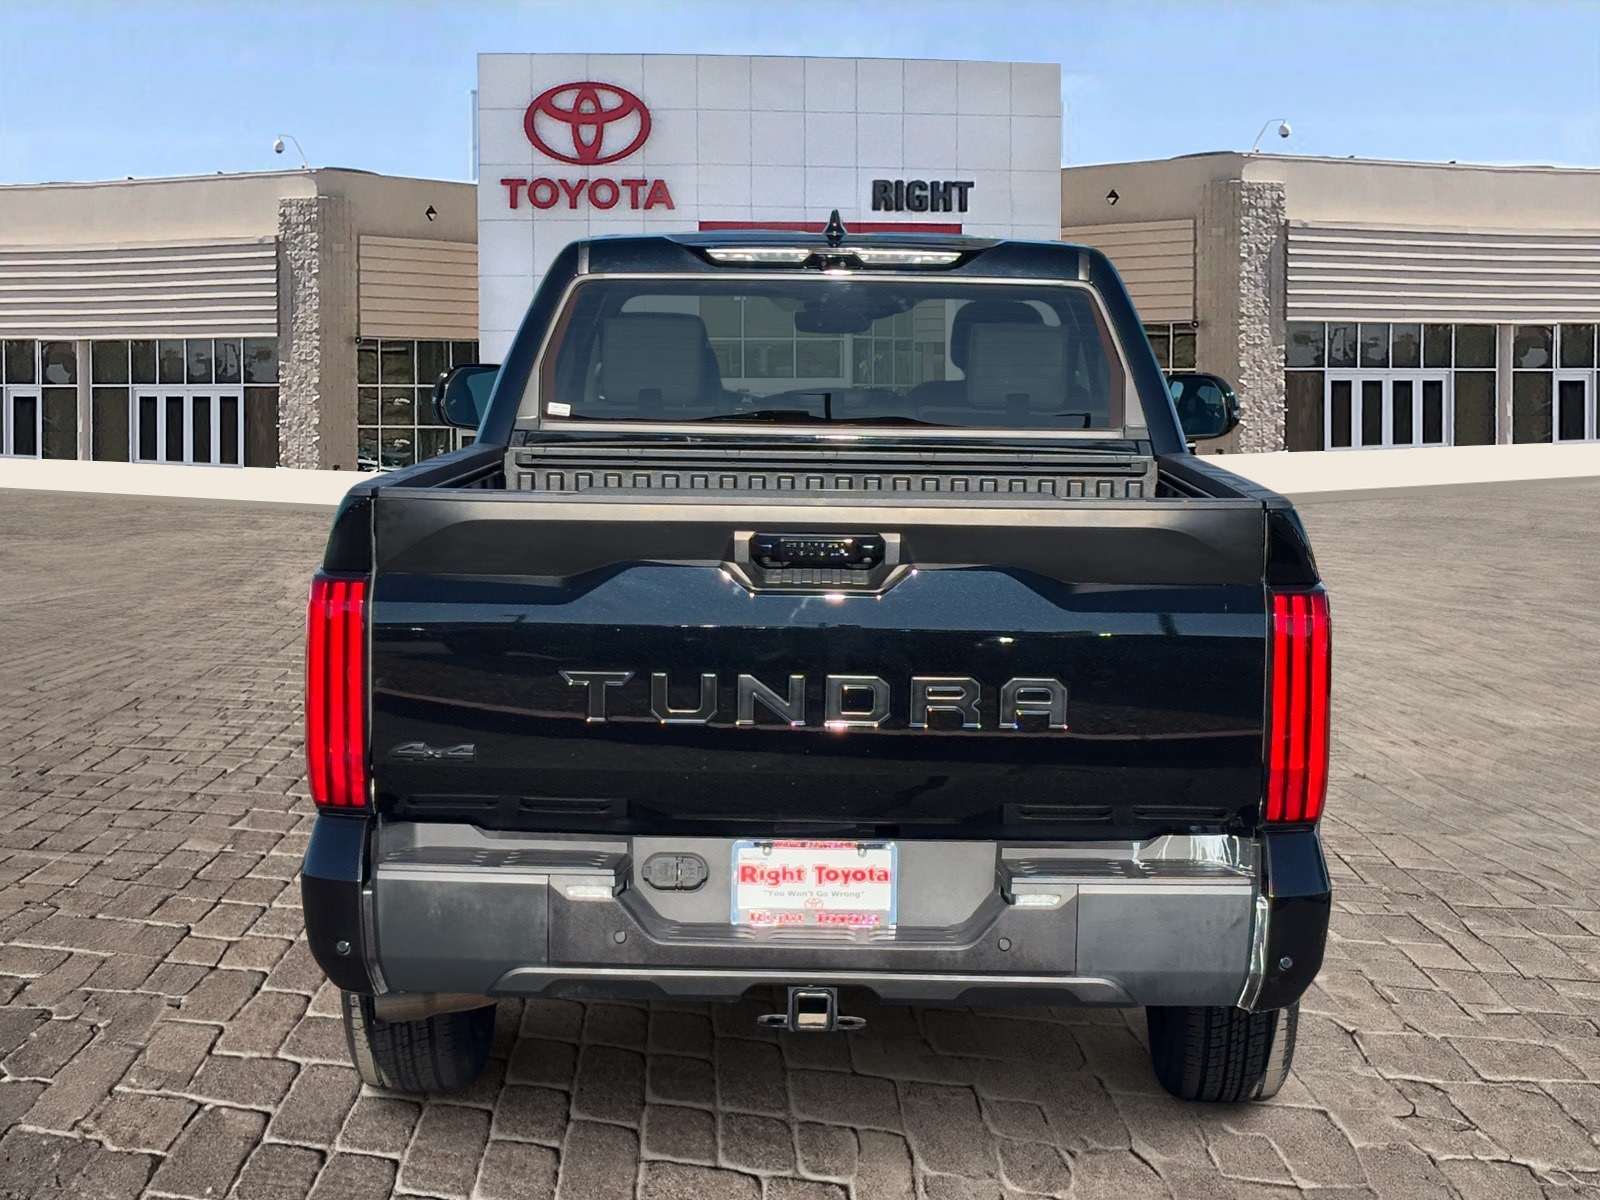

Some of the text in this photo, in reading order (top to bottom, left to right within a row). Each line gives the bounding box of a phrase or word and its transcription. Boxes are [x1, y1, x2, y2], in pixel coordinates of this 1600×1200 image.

[501, 178, 675, 210] TOYOTA
[872, 179, 975, 213] RIGHT
[559, 669, 1068, 731] TUNDRA
[739, 864, 890, 886] Right Toyota
